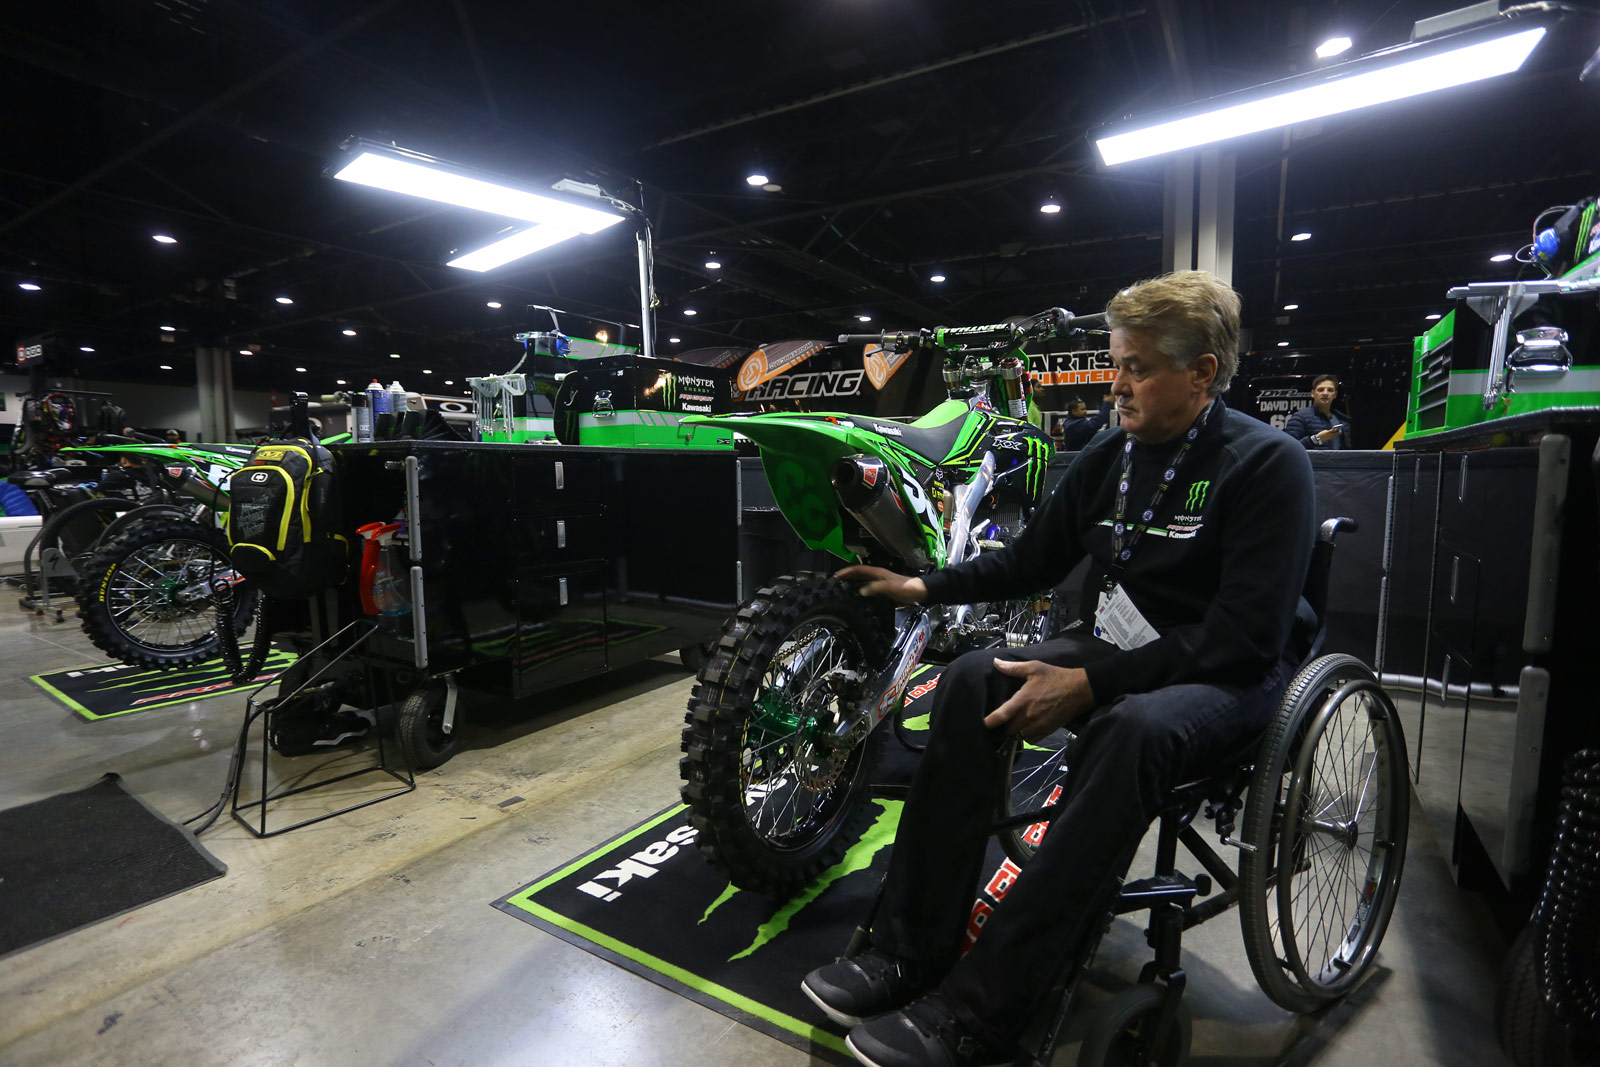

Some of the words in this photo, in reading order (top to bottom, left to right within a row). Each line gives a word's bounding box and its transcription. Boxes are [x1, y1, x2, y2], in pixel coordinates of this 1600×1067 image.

[1029, 350, 1114, 373] ARTS
[678, 375, 715, 389] MONSTER
[682, 402, 712, 413] Kawasaki
[1260, 400, 1289, 412] DAVID
[99, 562, 117, 602] DUNLOP
